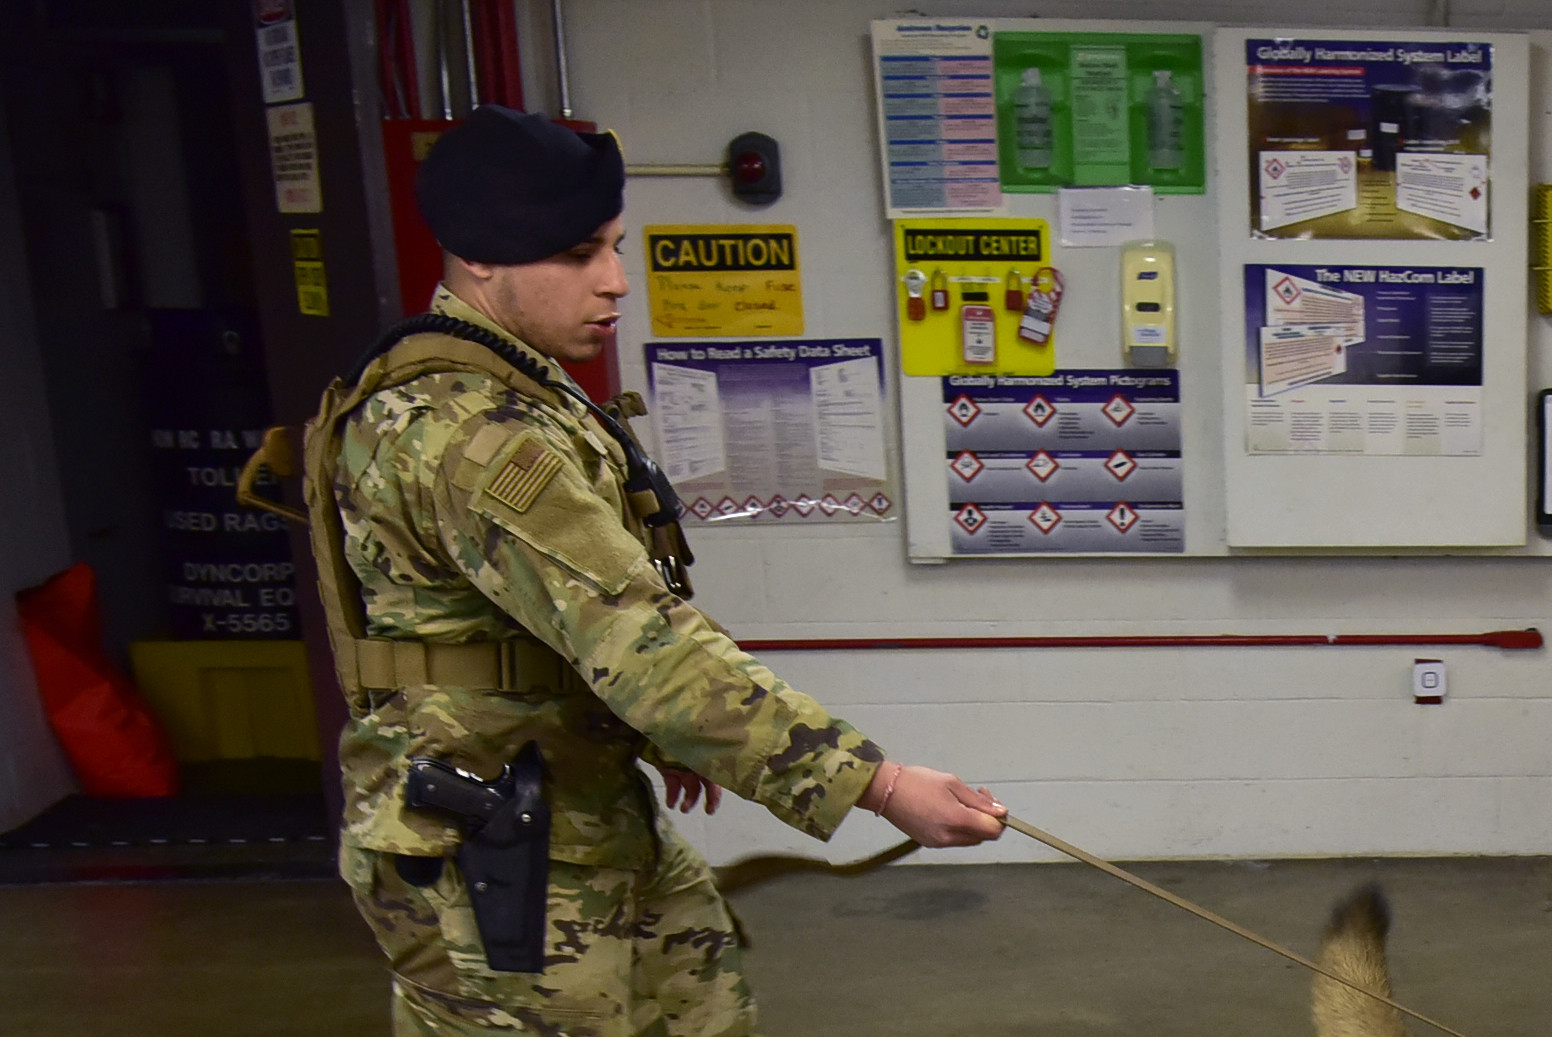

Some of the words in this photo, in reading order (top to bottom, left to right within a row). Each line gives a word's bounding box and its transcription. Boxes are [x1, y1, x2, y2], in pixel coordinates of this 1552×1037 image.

[1257, 45, 1312, 63] Globally
[1315, 48, 1394, 62] Harmonized
[1396, 49, 1445, 64] System
[1447, 50, 1482, 63] Label
[655, 238, 790, 267] CAUTION
[905, 235, 975, 255] LOCKOUT
[979, 235, 1039, 256] CENTER
[1315, 269, 1341, 282] The
[1343, 270, 1376, 283] NEW
[1437, 271, 1475, 284] Label
[656, 348, 688, 361] How
[691, 348, 706, 360] to
[708, 347, 741, 360] Read
[744, 349, 752, 359] a
[754, 346, 796, 361] Safety
[799, 346, 831, 358] Data
[833, 344, 872, 357] Sheet
[1066, 375, 1108, 389] System
[1109, 375, 1171, 388] Pictograms
[183, 562, 295, 583] DYNCORP
[201, 612, 291, 633] X-5565
